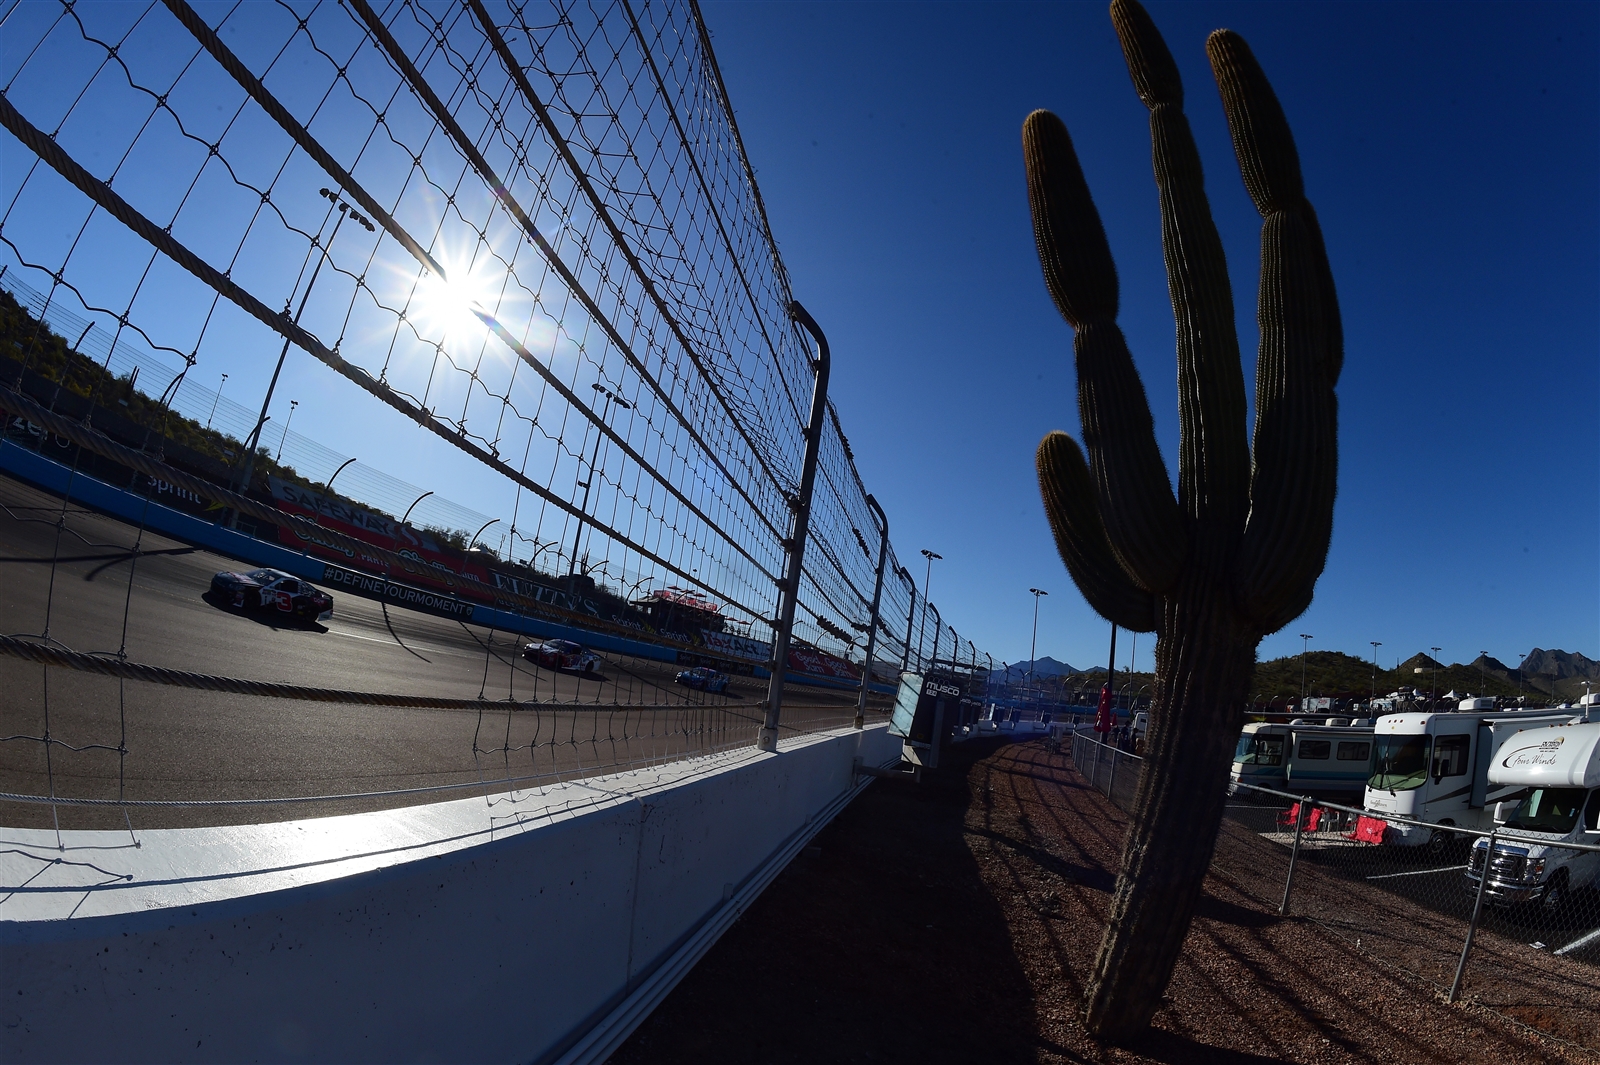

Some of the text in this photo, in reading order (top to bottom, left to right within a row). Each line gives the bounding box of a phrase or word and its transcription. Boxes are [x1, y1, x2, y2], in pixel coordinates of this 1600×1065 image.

[282, 486, 389, 535] SAFEWAY
[276, 591, 293, 613] 3
[324, 567, 466, 615] #DEFINEYOURMOMENT
[659, 627, 692, 644] Sprint
